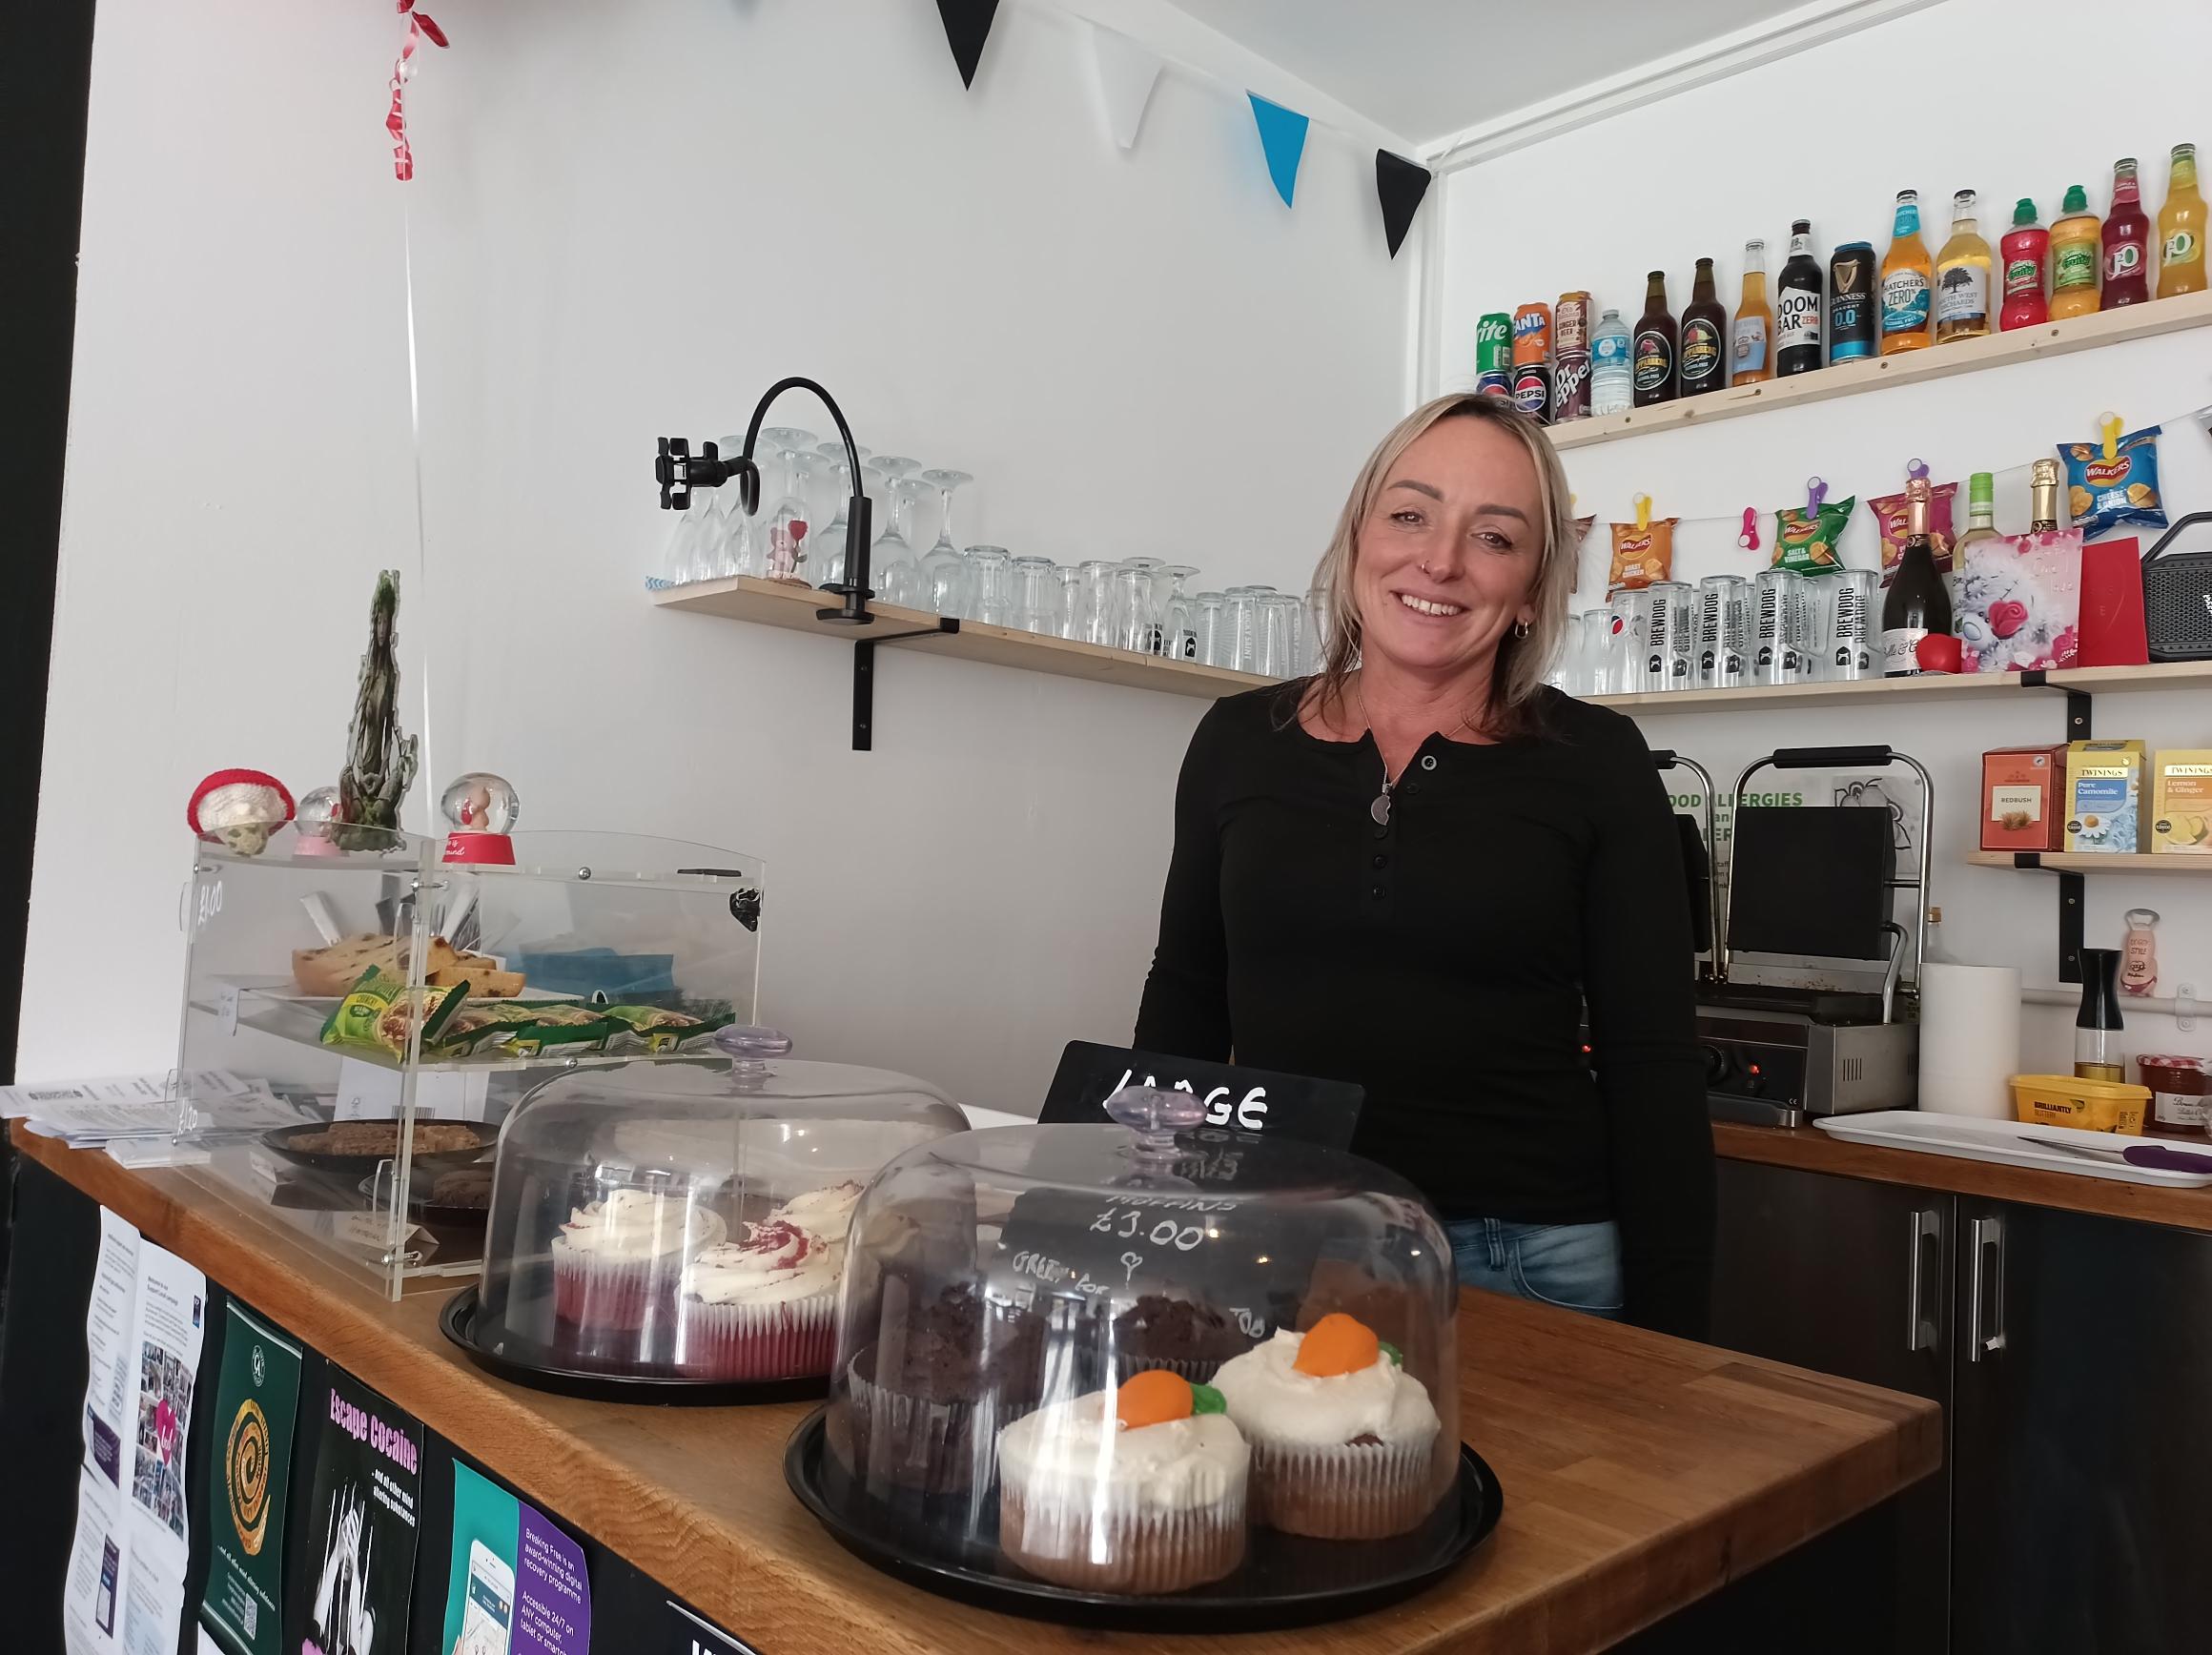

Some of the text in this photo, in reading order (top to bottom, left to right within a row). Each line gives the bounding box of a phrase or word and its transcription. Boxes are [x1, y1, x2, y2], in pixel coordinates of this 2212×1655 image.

[1883, 277, 1924, 292] HATCHERS
[1477, 319, 1508, 343] rite
[1834, 309, 1857, 328] 0.0
[1516, 389, 1545, 400] PEPSI
[1556, 359, 1591, 408] epper
[2086, 460, 2130, 477] WALKERS
[2096, 488, 2126, 502] CHEESE
[1787, 547, 1801, 557] SALT
[1649, 599, 1667, 646] BREWDOG
[1702, 593, 1718, 643] BREWDOG
[1758, 588, 1776, 639] BREWDOG
[1836, 587, 1854, 639] BREWDOG
[2080, 768, 2123, 778] TWININGS
[1716, 792, 1804, 807] LLERGIES
[2078, 787, 2120, 796] Camomile
[2174, 786, 2204, 794] Ginger
[2034, 1101, 2072, 1114] BRILLIANTLY
[2034, 1108, 2057, 1119] BUTTERY
[1089, 1207, 1203, 1251] £3.00
[330, 1388, 418, 1476] Escape Cocaine
[525, 1527, 575, 1572] Breaking Free is an
[524, 1543, 583, 1592] award-winning digital
[524, 1558, 582, 1604] recovery programme
[521, 1604, 563, 1645] ANY computer,
[522, 1590, 574, 1637] Accessible 24/7 on
[521, 1618, 536, 1639] tablet
[536, 1632, 543, 1644] or
